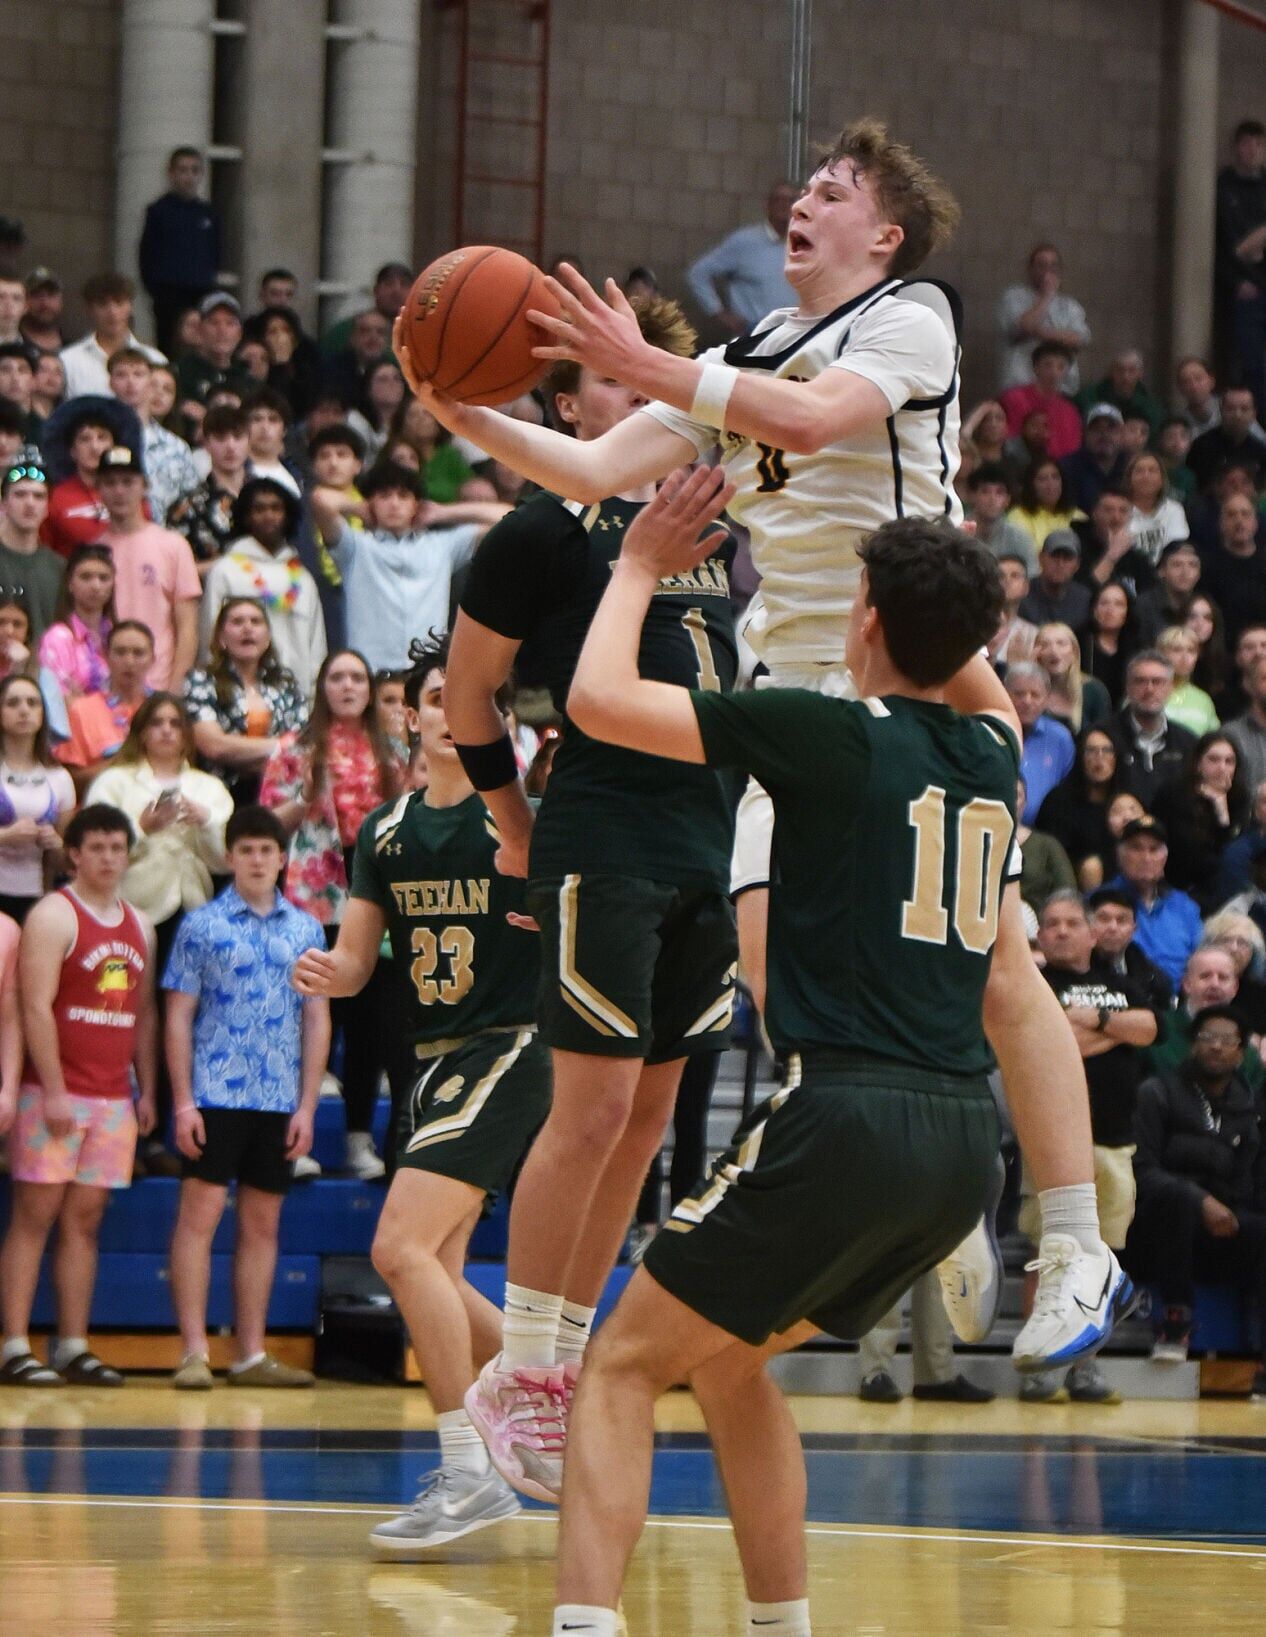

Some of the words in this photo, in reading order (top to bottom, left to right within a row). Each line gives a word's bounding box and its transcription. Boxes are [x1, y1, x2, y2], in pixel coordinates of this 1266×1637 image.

[681, 607, 721, 694] 1
[901, 784, 1014, 955] 10
[410, 926, 475, 1005] 23
